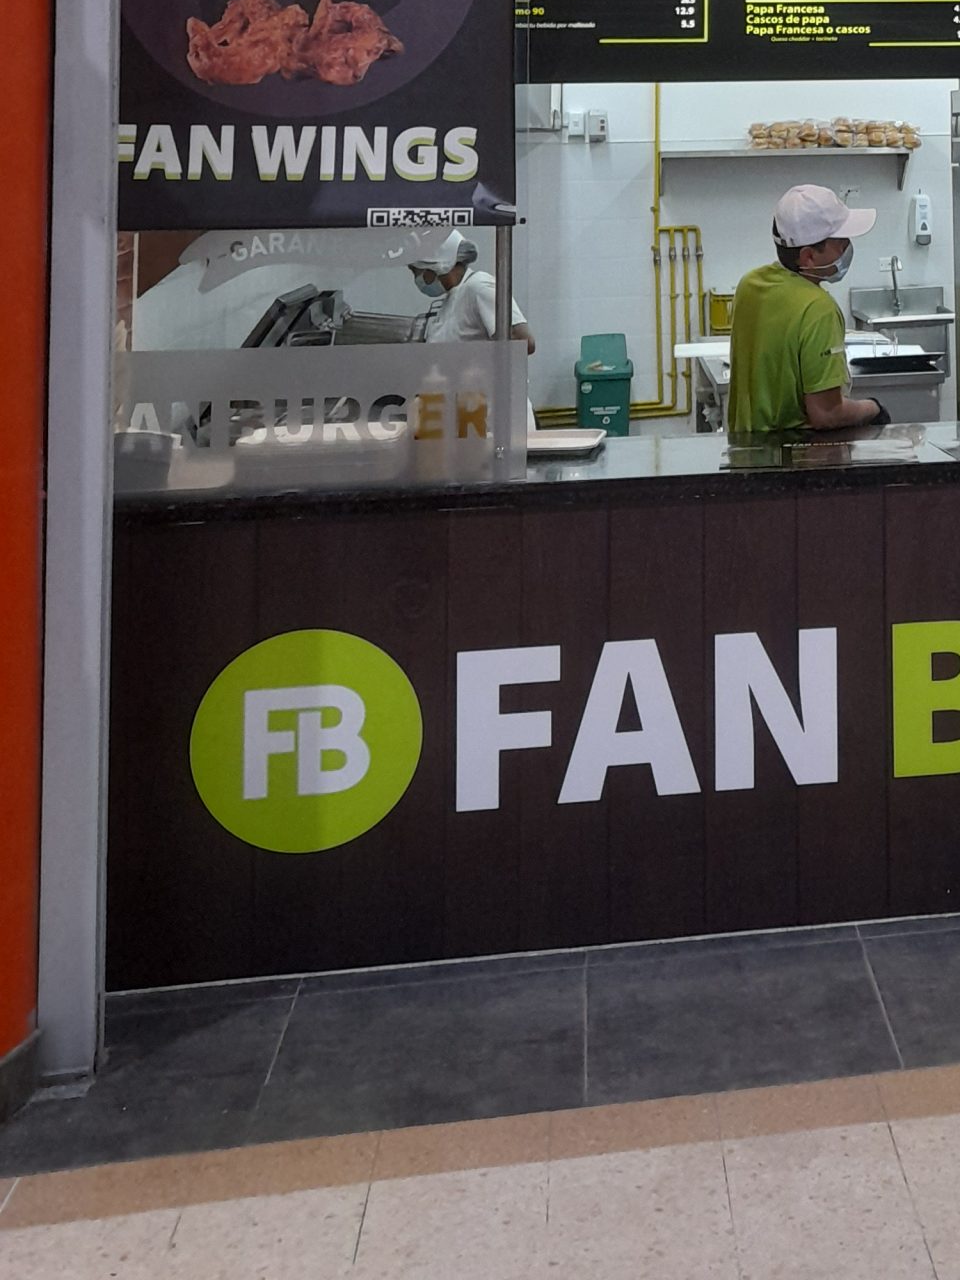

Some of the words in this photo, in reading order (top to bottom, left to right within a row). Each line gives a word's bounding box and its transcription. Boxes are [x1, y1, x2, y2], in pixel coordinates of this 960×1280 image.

[532, 7, 545, 15] 90
[675, 7, 695, 15] 12.9
[746, 4, 774, 15] Papa
[776, 4, 825, 14] Francesa
[746, 15, 784, 24] Cascos
[785, 15, 800, 24] de
[802, 16, 830, 26] papa
[746, 25, 774, 36] Papa
[776, 25, 824, 34] Francesa
[251, 125, 480, 182] WINGS
[130, 400, 212, 448] AN
[229, 393, 488, 446] BURGER
[455, 627, 839, 813] FAN
[242, 683, 371, 800] FB
